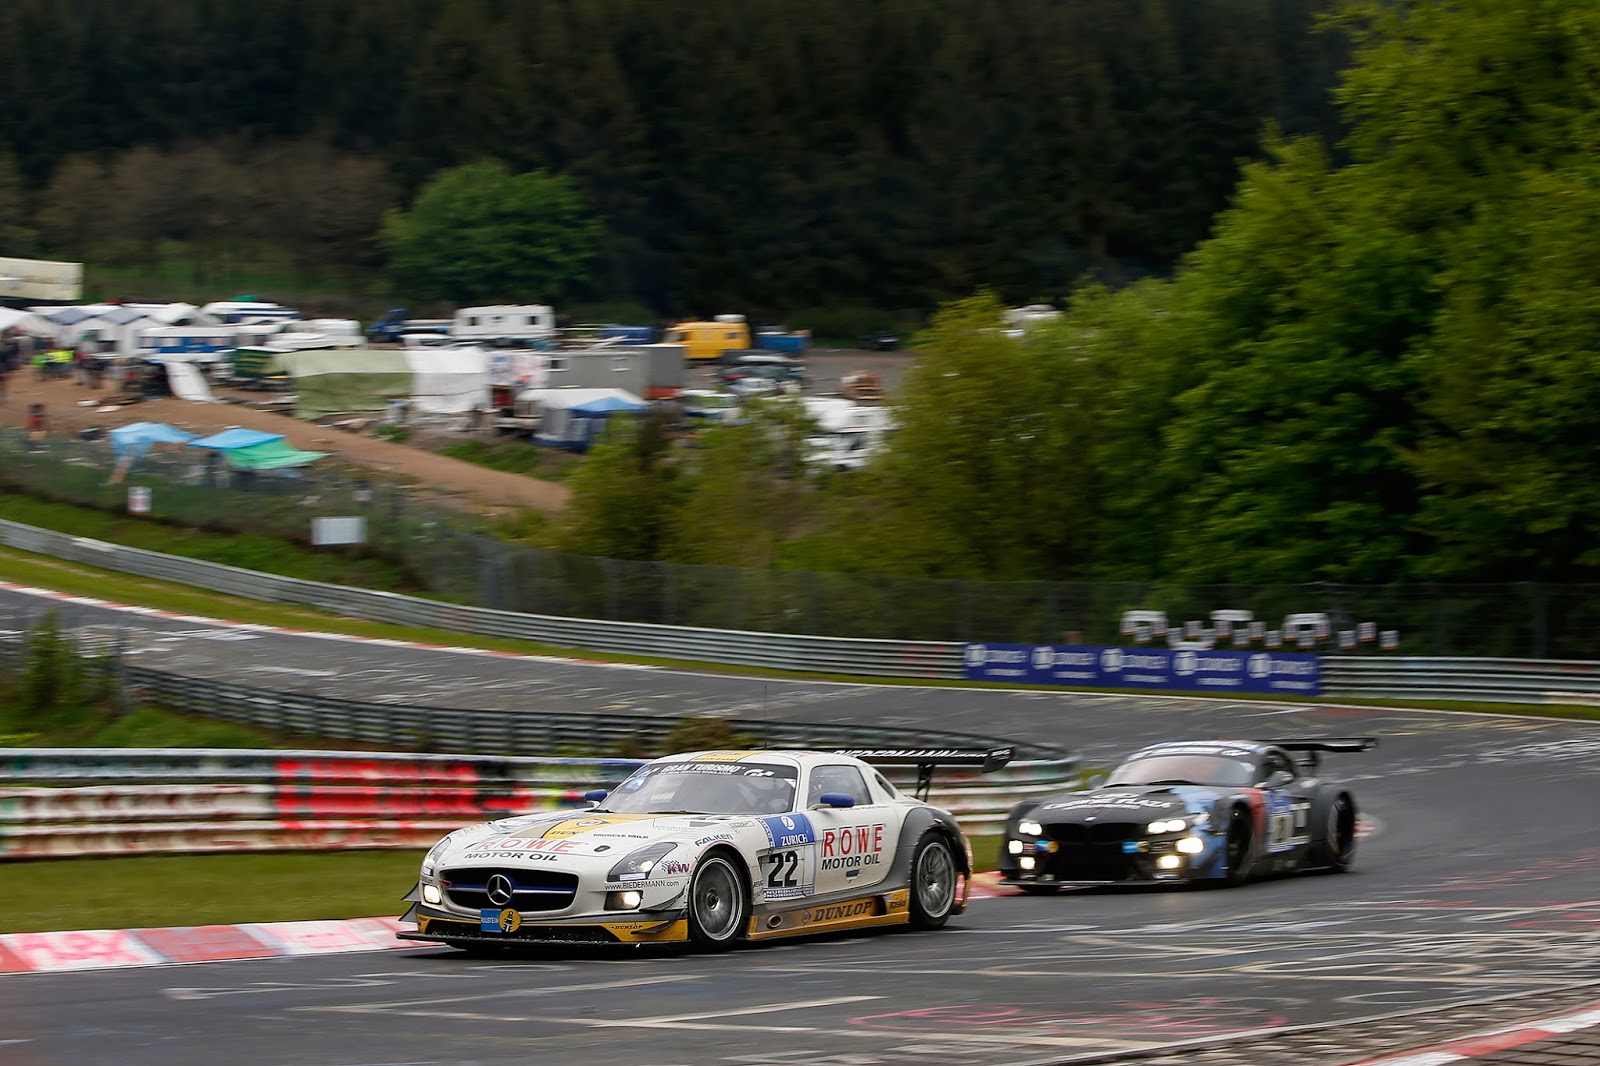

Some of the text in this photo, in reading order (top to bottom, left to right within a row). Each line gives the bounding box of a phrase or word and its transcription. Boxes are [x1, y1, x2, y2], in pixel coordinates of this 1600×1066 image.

[660, 763, 694, 773] GRAN
[693, 763, 742, 773] TURISMO
[478, 839, 581, 852] ROWE
[694, 833, 734, 847] FALKEN
[781, 833, 808, 846] ZURICH
[823, 826, 883, 857] ROWE
[528, 853, 559, 861] OIL
[821, 853, 880, 870] MOTOR OIL
[768, 850, 798, 888] 22
[604, 880, 680, 891] www.BIEDERMANN.com
[813, 901, 872, 922] DUNLOP
